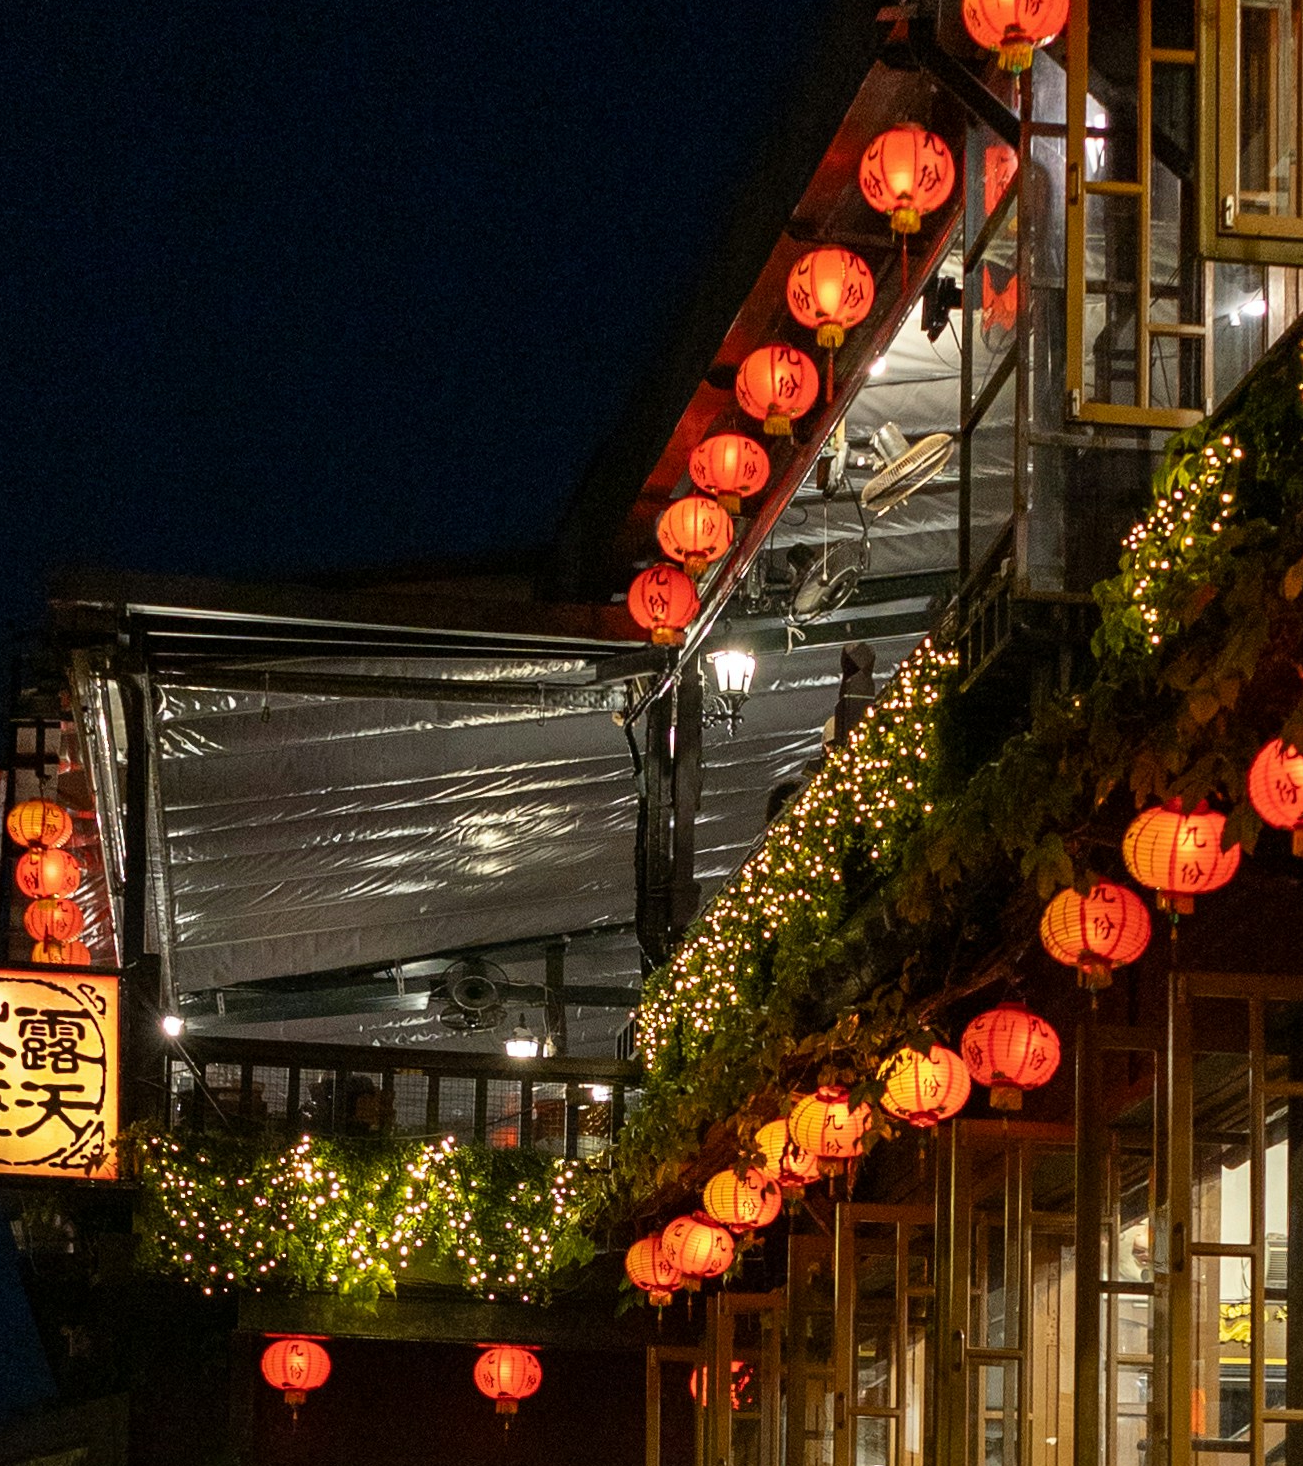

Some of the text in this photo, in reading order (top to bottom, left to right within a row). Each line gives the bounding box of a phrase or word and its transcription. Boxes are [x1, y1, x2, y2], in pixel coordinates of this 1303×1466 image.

[918, 132, 945, 191] 九份
[845, 252, 864, 308] 九份
[778, 347, 800, 398] 九份
[743, 440, 758, 480] 九份
[700, 499, 715, 536] 九份
[648, 565, 669, 616] 九份
[1181, 824, 1206, 884] 九份
[1092, 884, 1115, 941] 九份
[1030, 1018, 1049, 1071] 九份
[824, 1113, 843, 1155] 九份
[742, 1174, 757, 1215] 九份
[290, 1343, 306, 1381] 九份
